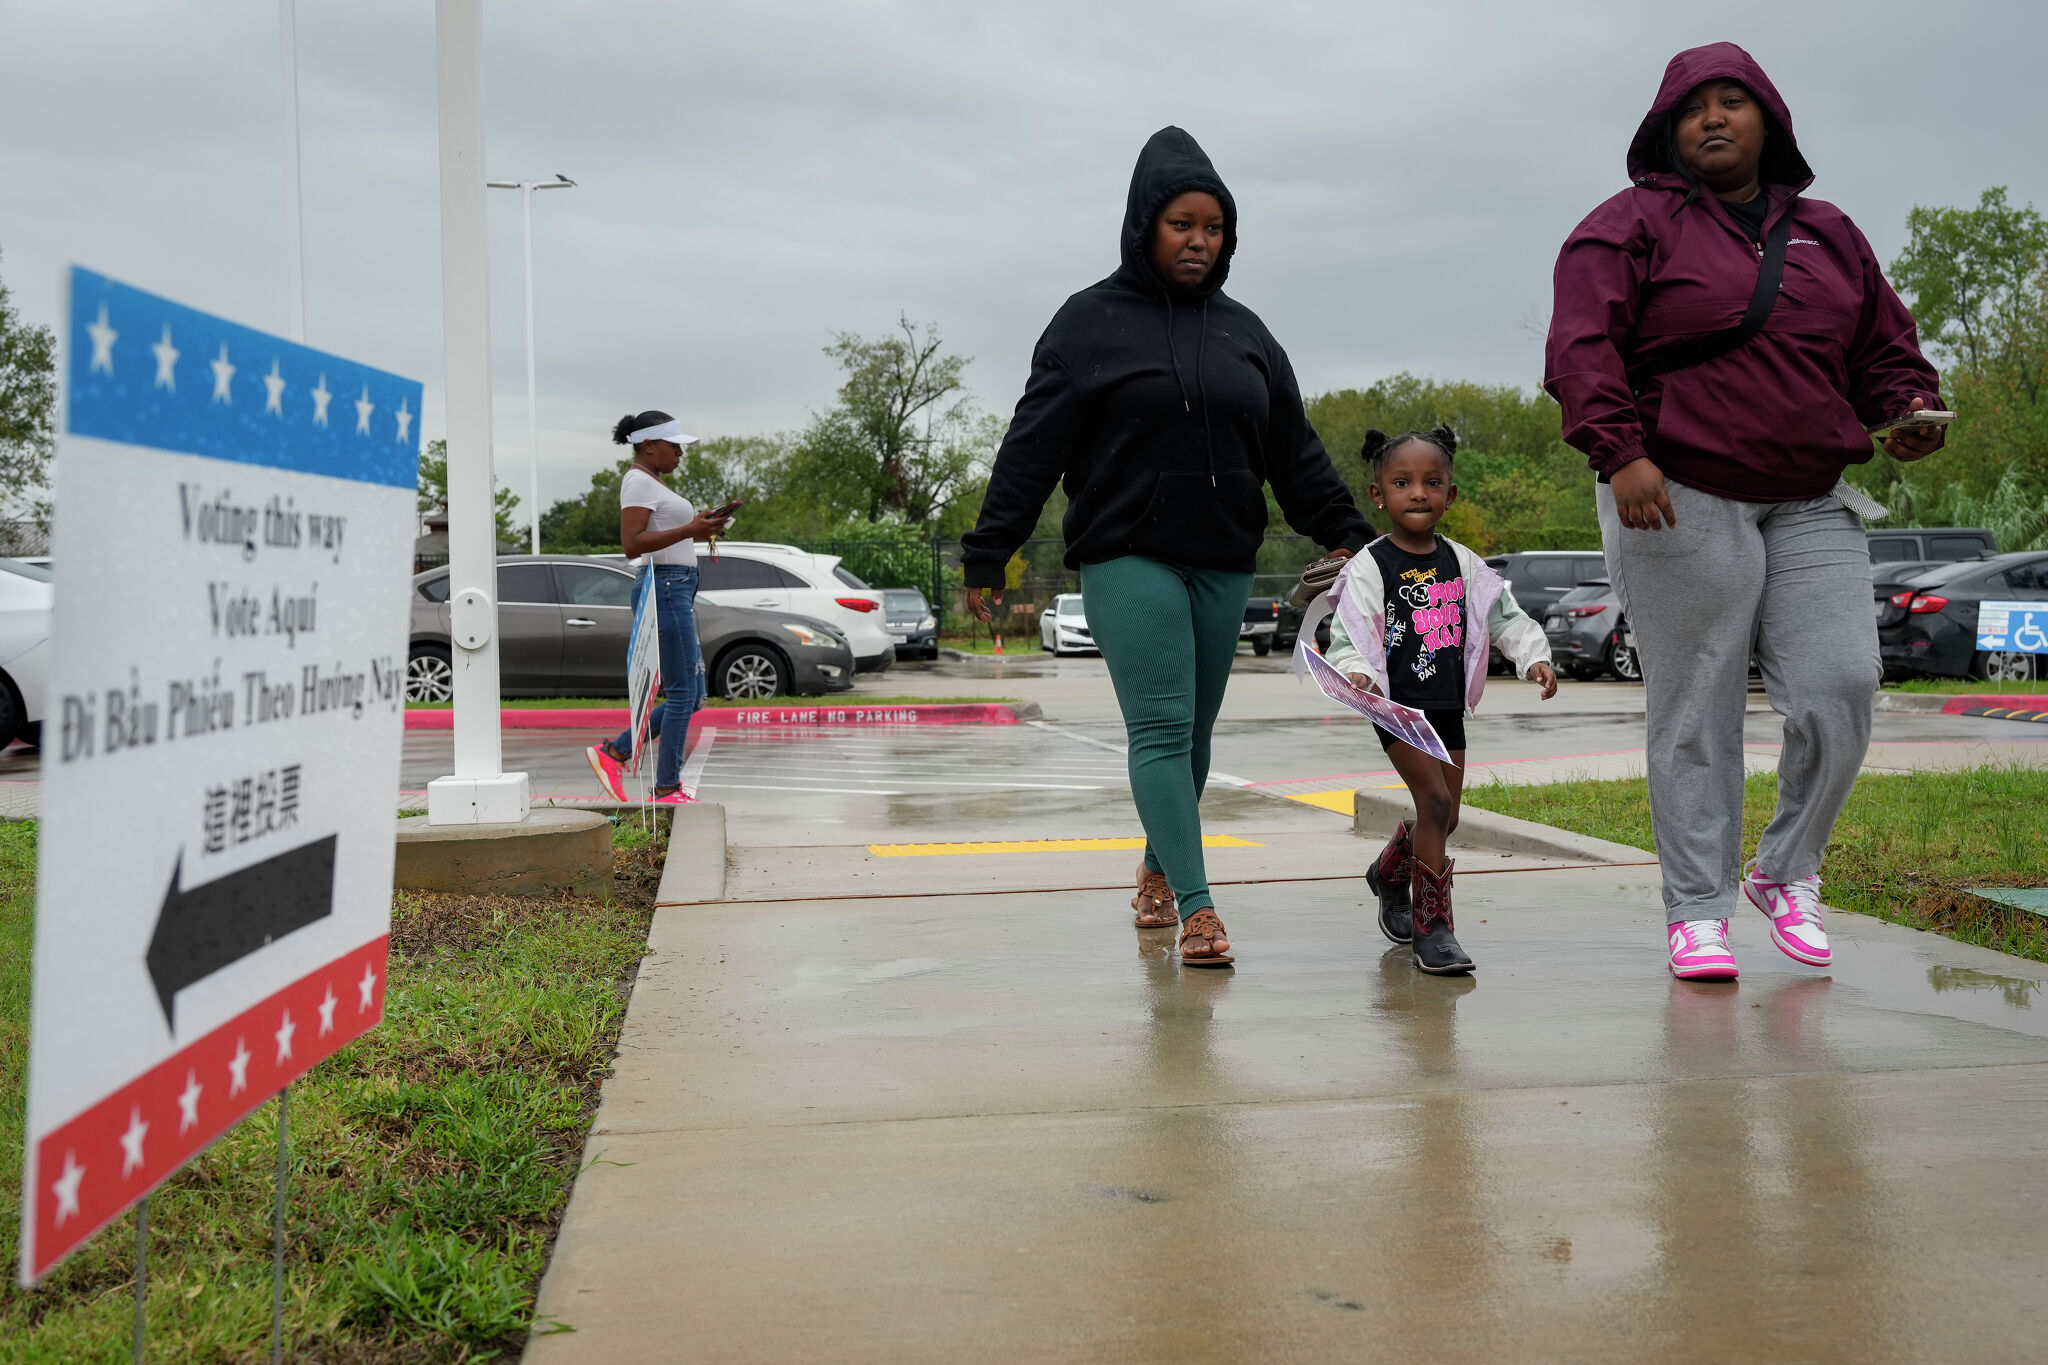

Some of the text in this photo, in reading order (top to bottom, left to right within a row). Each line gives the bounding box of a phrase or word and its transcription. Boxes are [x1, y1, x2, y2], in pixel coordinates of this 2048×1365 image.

[179, 481, 347, 564] Voting this way
[1413, 567, 1438, 583] GREAT
[208, 581, 319, 649] Vote Aquí
[1386, 600, 1396, 628] NEXT
[1412, 602, 1461, 634] YOUR
[1390, 619, 1407, 648] TIME
[1423, 625, 1462, 652] WAY
[1420, 643, 1428, 653] A
[1410, 651, 1436, 673] GOOD
[1417, 663, 1437, 682] DAY
[241, 670, 296, 726] Theo
[367, 656, 405, 713] Này
[737, 709, 918, 724] FIRE LANE NO PARKING
